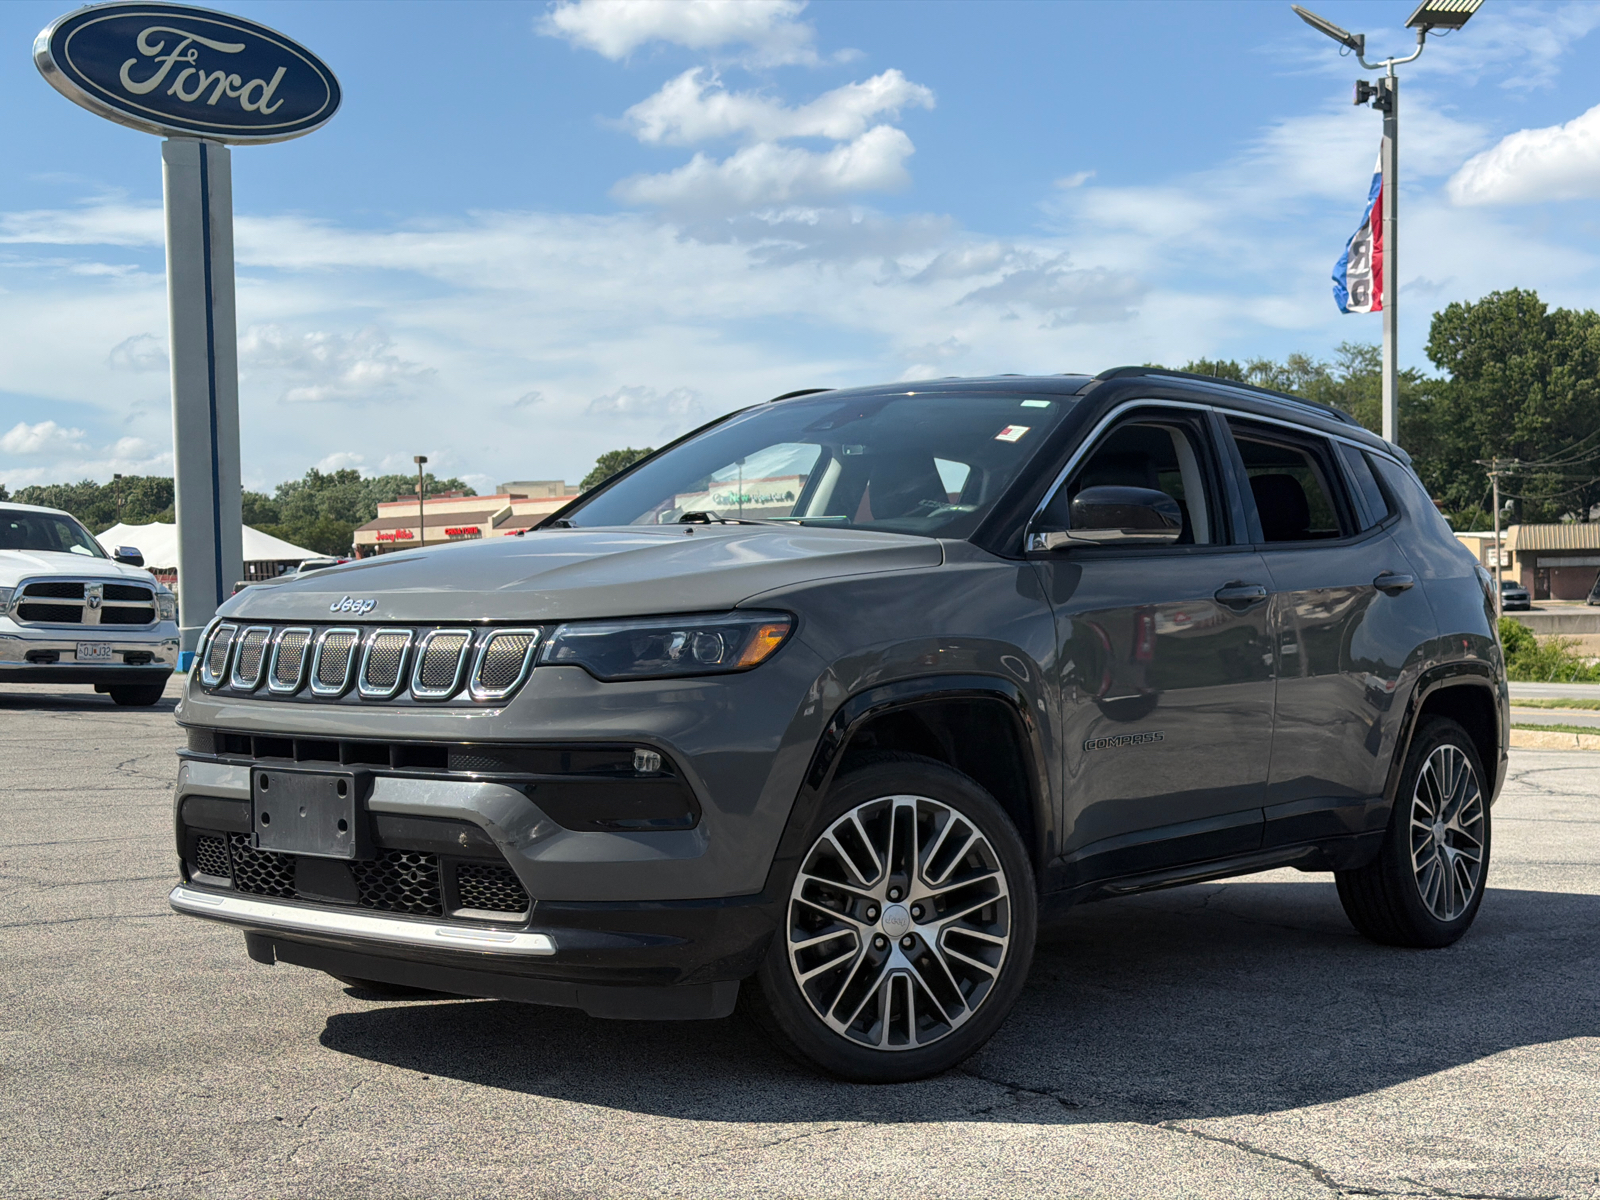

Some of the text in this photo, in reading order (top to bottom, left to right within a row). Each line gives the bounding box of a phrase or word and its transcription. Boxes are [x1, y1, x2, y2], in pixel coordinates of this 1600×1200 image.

[119, 26, 287, 115] Ford
[330, 595, 377, 616] Jeep
[1083, 730, 1165, 751] COMPASS
